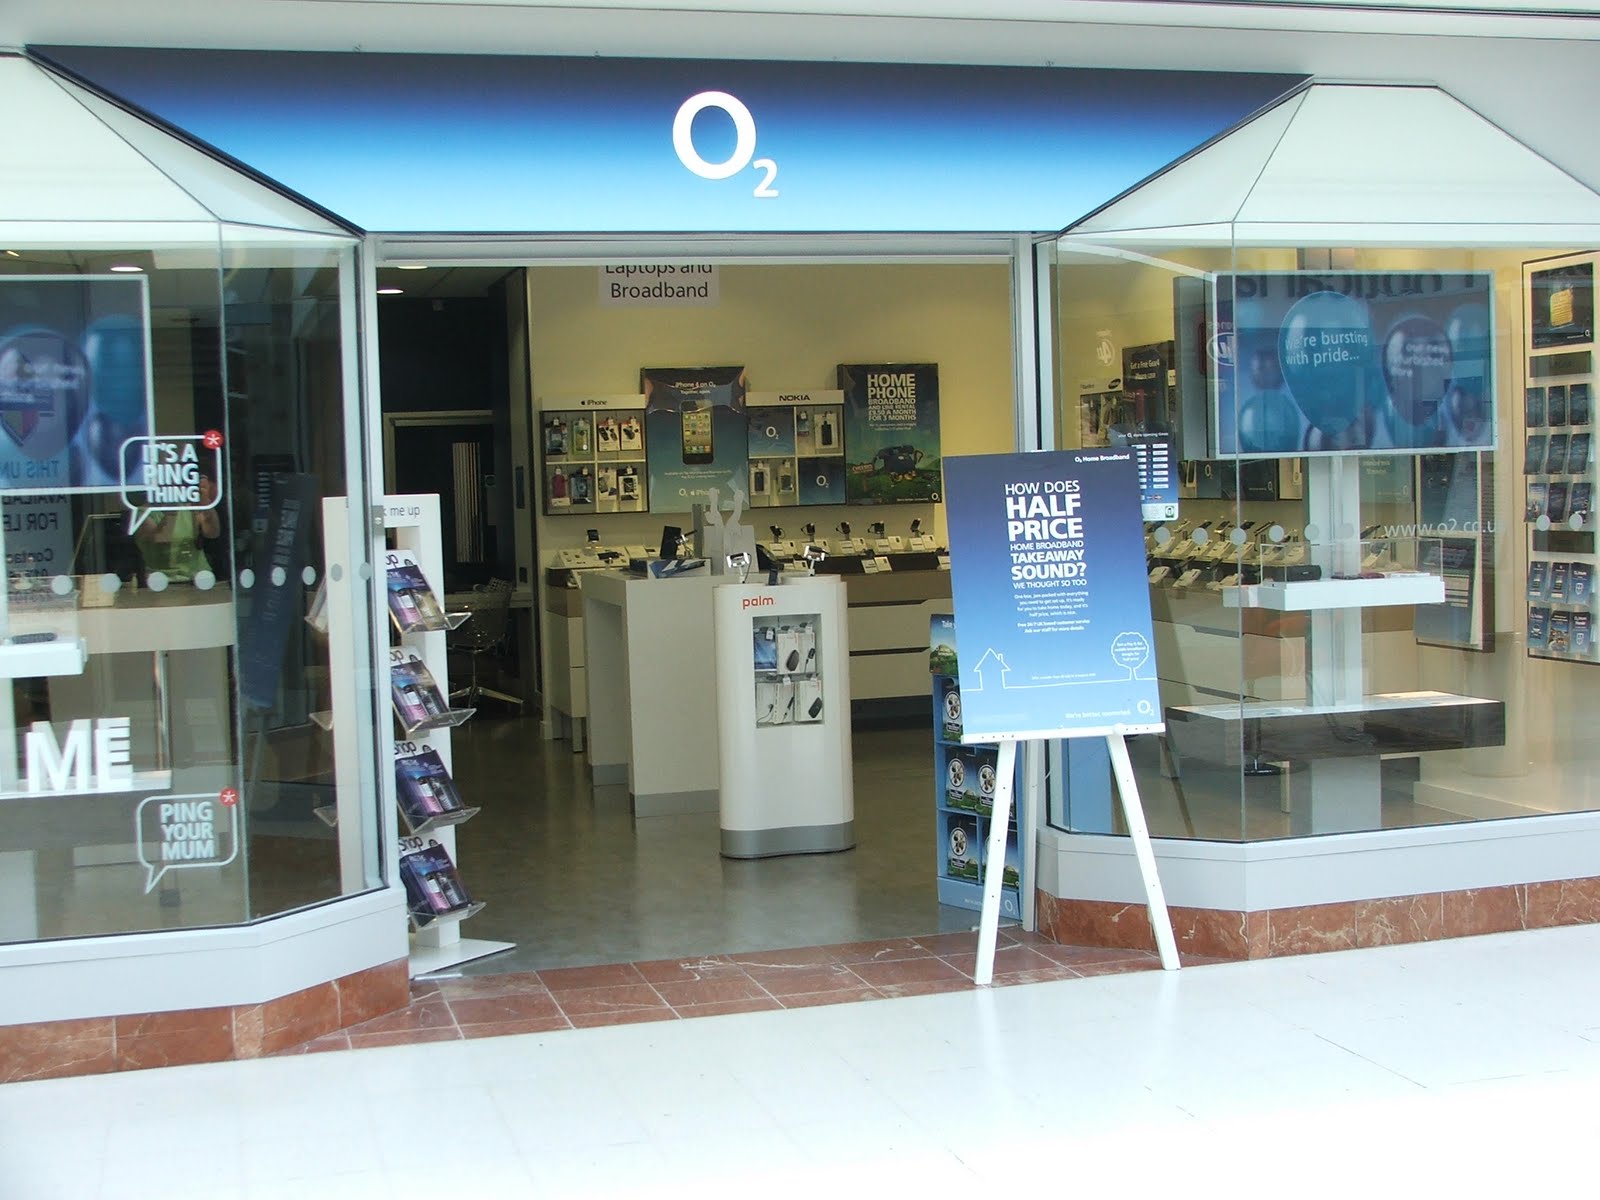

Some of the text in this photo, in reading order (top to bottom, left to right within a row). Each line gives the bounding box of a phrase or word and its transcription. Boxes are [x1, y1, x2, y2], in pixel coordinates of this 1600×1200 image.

[672, 90, 779, 198] O2
[680, 265, 712, 274] and
[611, 281, 708, 298] Broadband
[1321, 331, 1368, 347] bursting
[1286, 347, 1360, 367] with pride...
[867, 374, 916, 387] HOME
[868, 387, 916, 398] PHONE
[766, 426, 779, 440] O2
[142, 442, 199, 463] IT'S A
[1100, 453, 1130, 461] Broadband
[143, 463, 200, 486] PING
[816, 475, 829, 488] O2
[146, 485, 201, 503] THING
[1005, 480, 1080, 495] HOW DOES
[390, 507, 405, 516] me
[407, 506, 421, 518] up
[1006, 493, 1081, 519] HALF
[1008, 517, 1084, 541] PRICE
[1010, 540, 1084, 551] HOME BROADBAND
[1010, 549, 1085, 564] TAKEAWAY
[1011, 561, 1087, 581] SOUND?
[1026, 580, 1059, 588] THOUGHT
[742, 595, 774, 610] palm
[25, 716, 134, 794] ME
[160, 801, 214, 824] PING
[161, 822, 215, 842] YOUR
[161, 839, 216, 861] MUM
